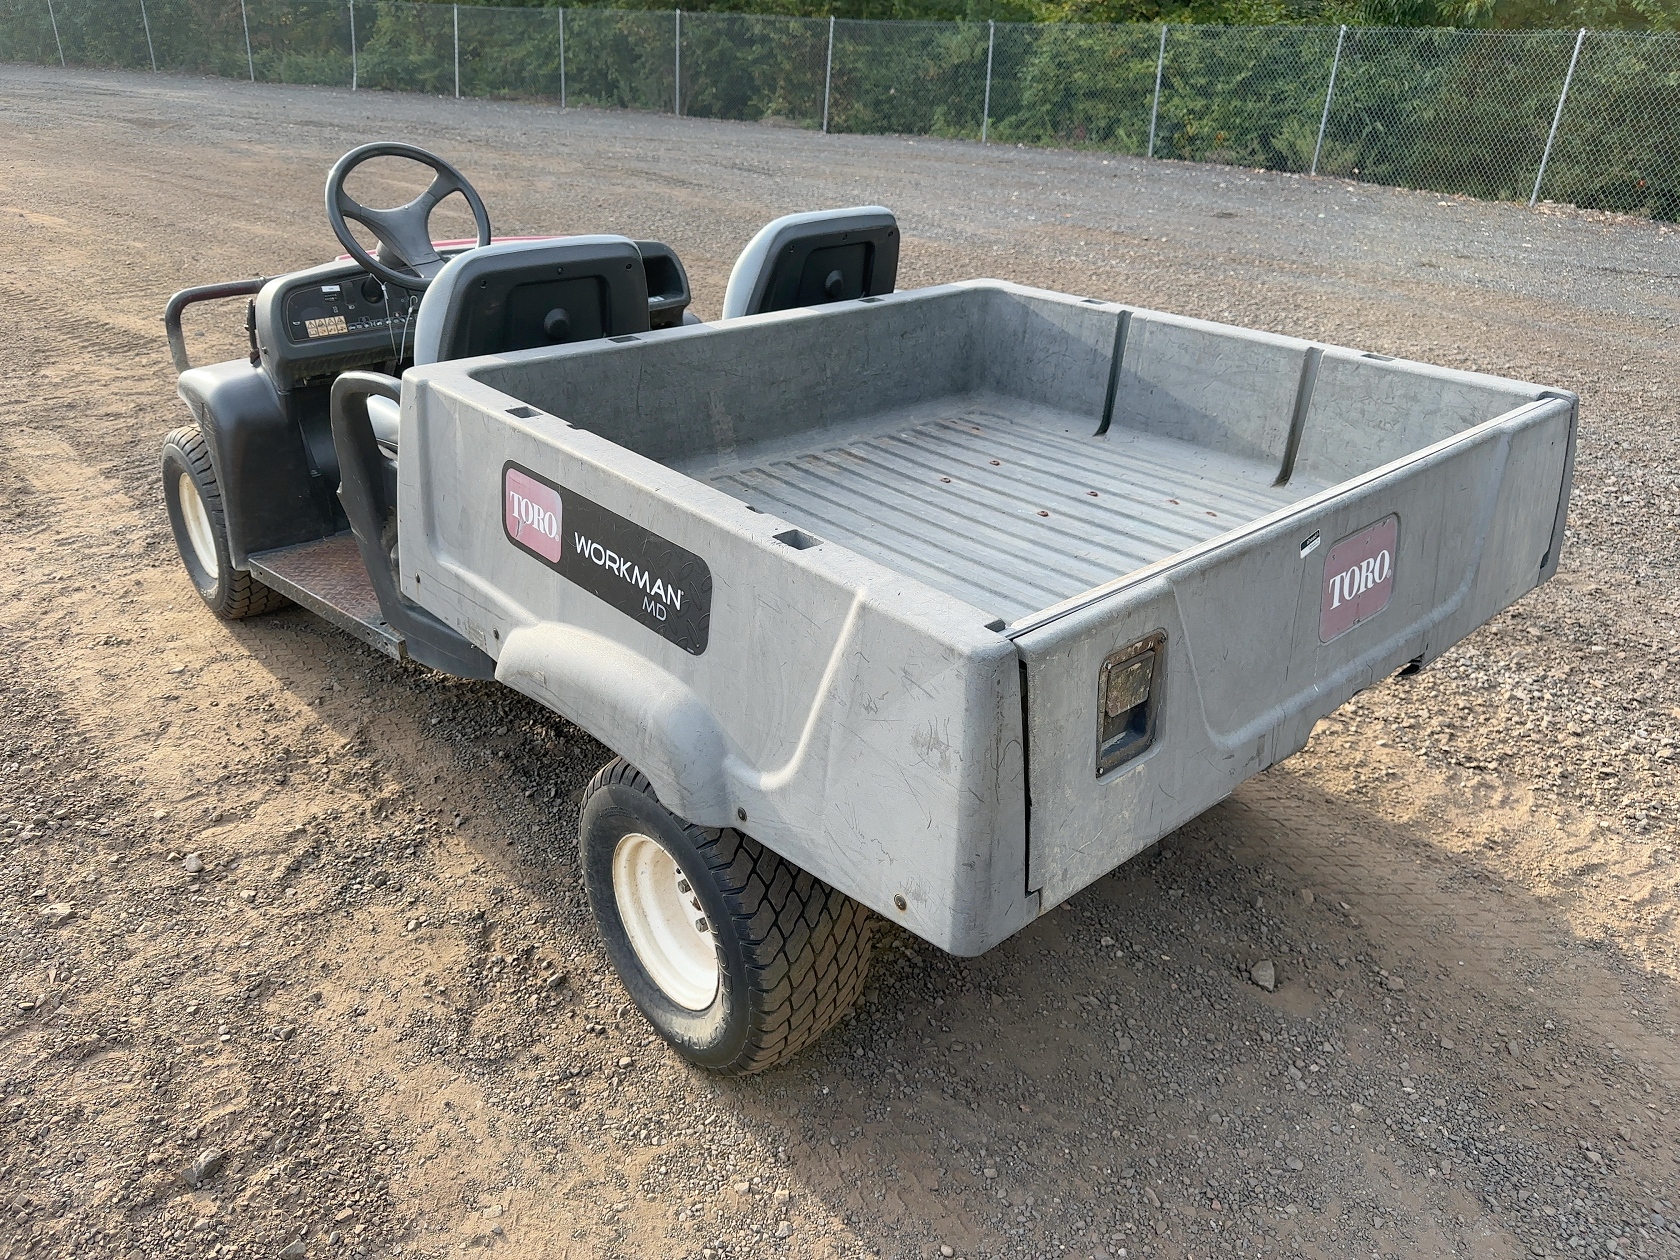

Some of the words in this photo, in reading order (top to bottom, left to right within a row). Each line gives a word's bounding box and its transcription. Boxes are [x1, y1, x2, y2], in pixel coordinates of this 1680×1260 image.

[510, 490, 559, 540] TORO
[574, 532, 682, 610] WORKMAN
[1328, 549, 1391, 610] TORO
[642, 596, 667, 621] MD
